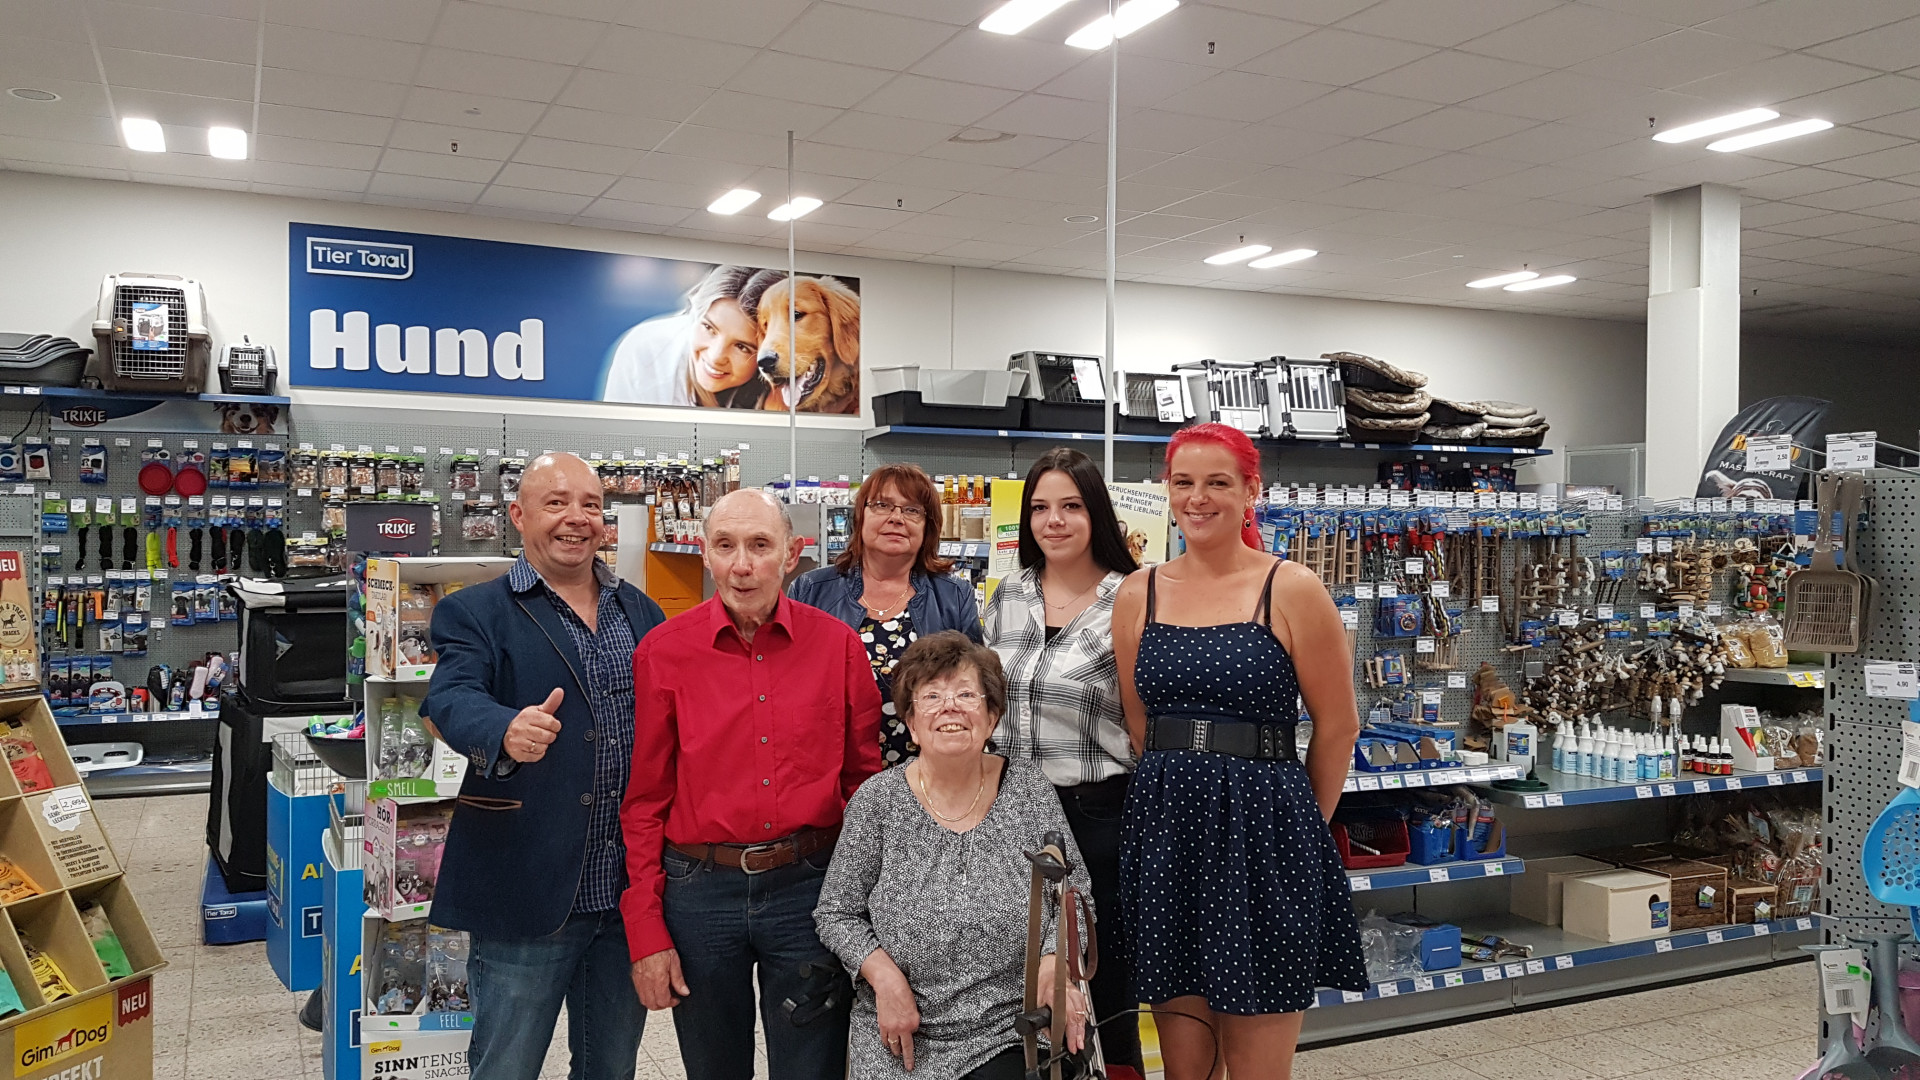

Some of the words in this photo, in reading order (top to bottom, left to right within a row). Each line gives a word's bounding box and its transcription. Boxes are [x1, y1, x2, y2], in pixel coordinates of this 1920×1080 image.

[313, 246, 353, 264] Tier
[309, 308, 545, 382] Hund
[61, 409, 107, 422] TRIXIE
[1719, 461, 1796, 482] MASTCRAFT
[1107, 484, 1168, 503] GERUCHSENTFERNER
[1125, 496, 1153, 507] REINIGER
[1119, 502, 1133, 511] IHRE
[1133, 505, 1163, 517] LIEBLINGE
[376, 522, 416, 535] TRIXIE
[12, 604, 27, 623] TREAT
[387, 782, 417, 796] SMELL
[121, 991, 147, 1015] NEU
[440, 1014, 460, 1028] FEEL
[42, 1056, 104, 1080] FEKT
[424, 1065, 470, 1079] SNACKE
